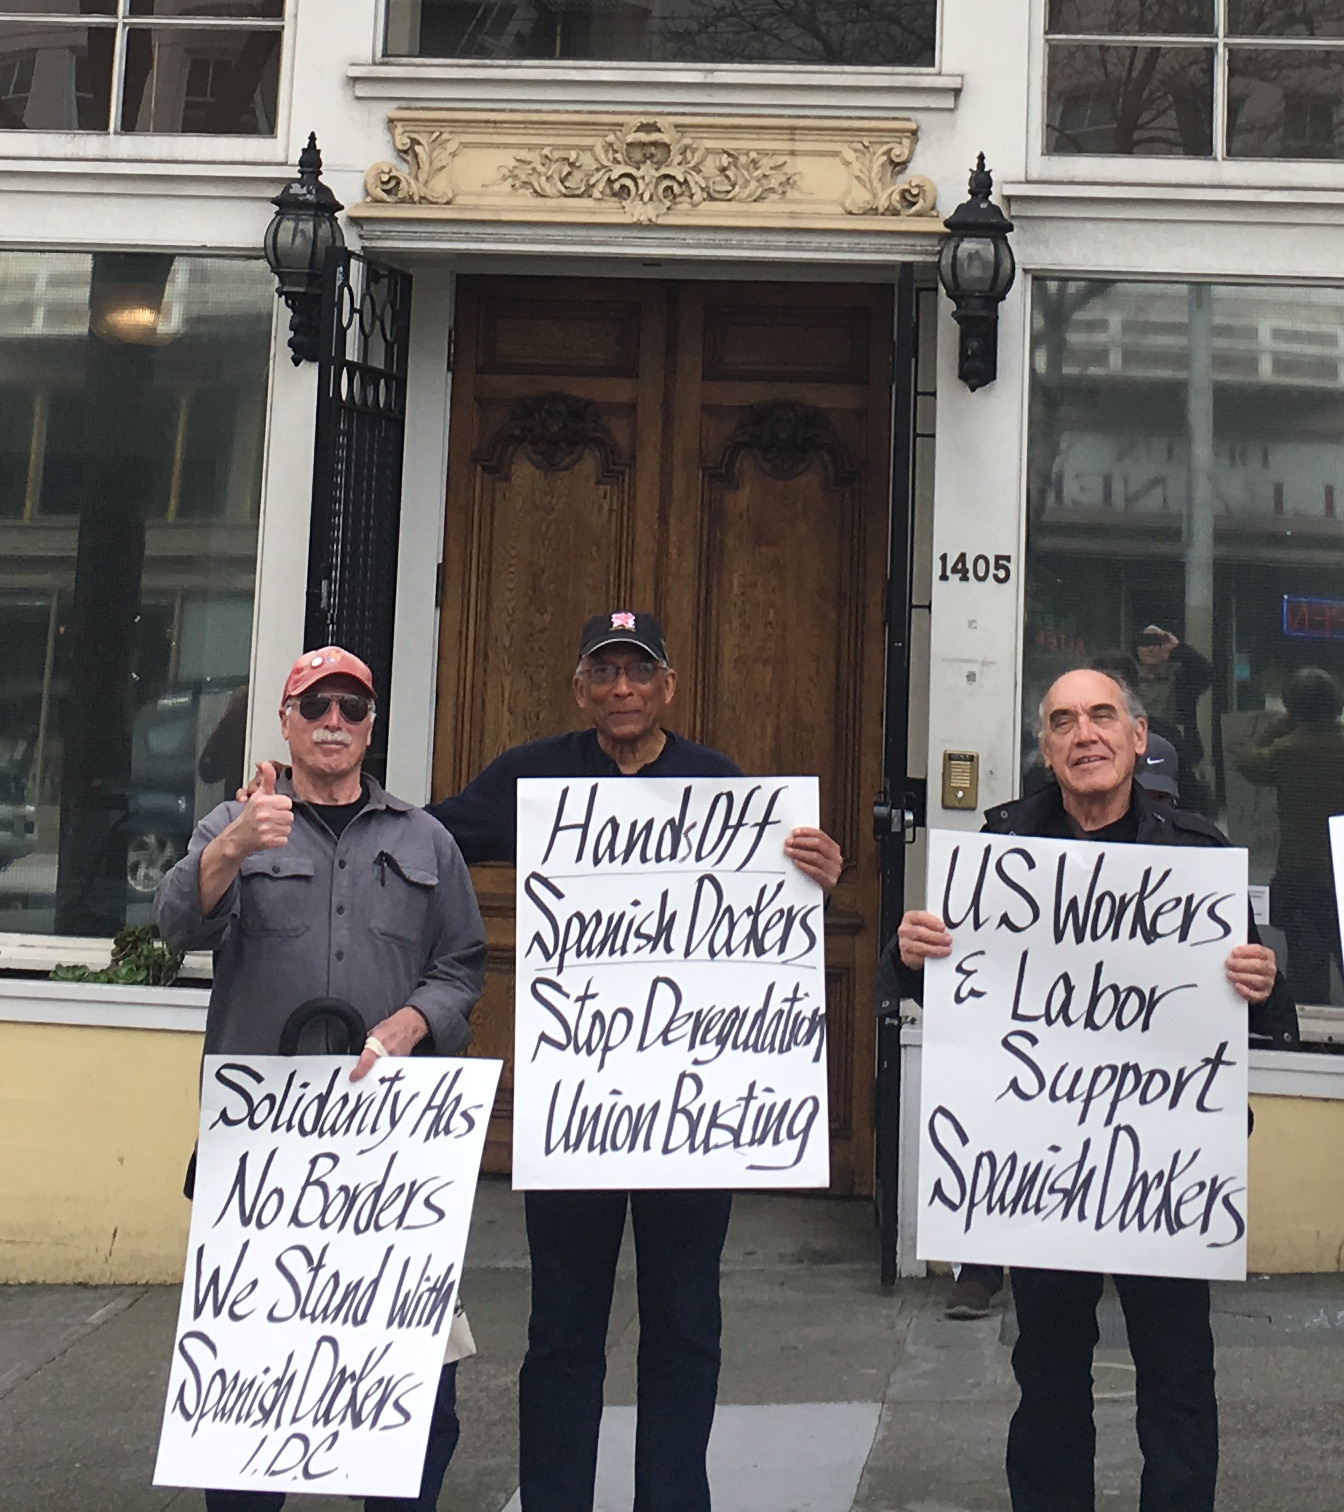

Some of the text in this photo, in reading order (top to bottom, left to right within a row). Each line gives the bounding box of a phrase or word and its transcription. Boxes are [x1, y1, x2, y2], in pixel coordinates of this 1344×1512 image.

[939, 552, 1011, 584] 1405
[524, 871, 821, 976] Spanish Dockers
[1054, 851, 1237, 947] Workers
[530, 975, 634, 1071] Stop
[1011, 948, 1198, 1033] Labor
[209, 1062, 484, 1156] Solidarity Has
[544, 1069, 820, 1170] Union Busting
[994, 1030, 1237, 1126] Support
[212, 1146, 455, 1236] No Borders
[927, 1105, 1247, 1248] Spanish Dockers
[192, 1239, 457, 1336] We Stand With
[171, 1330, 424, 1438] Spanish Dockers
